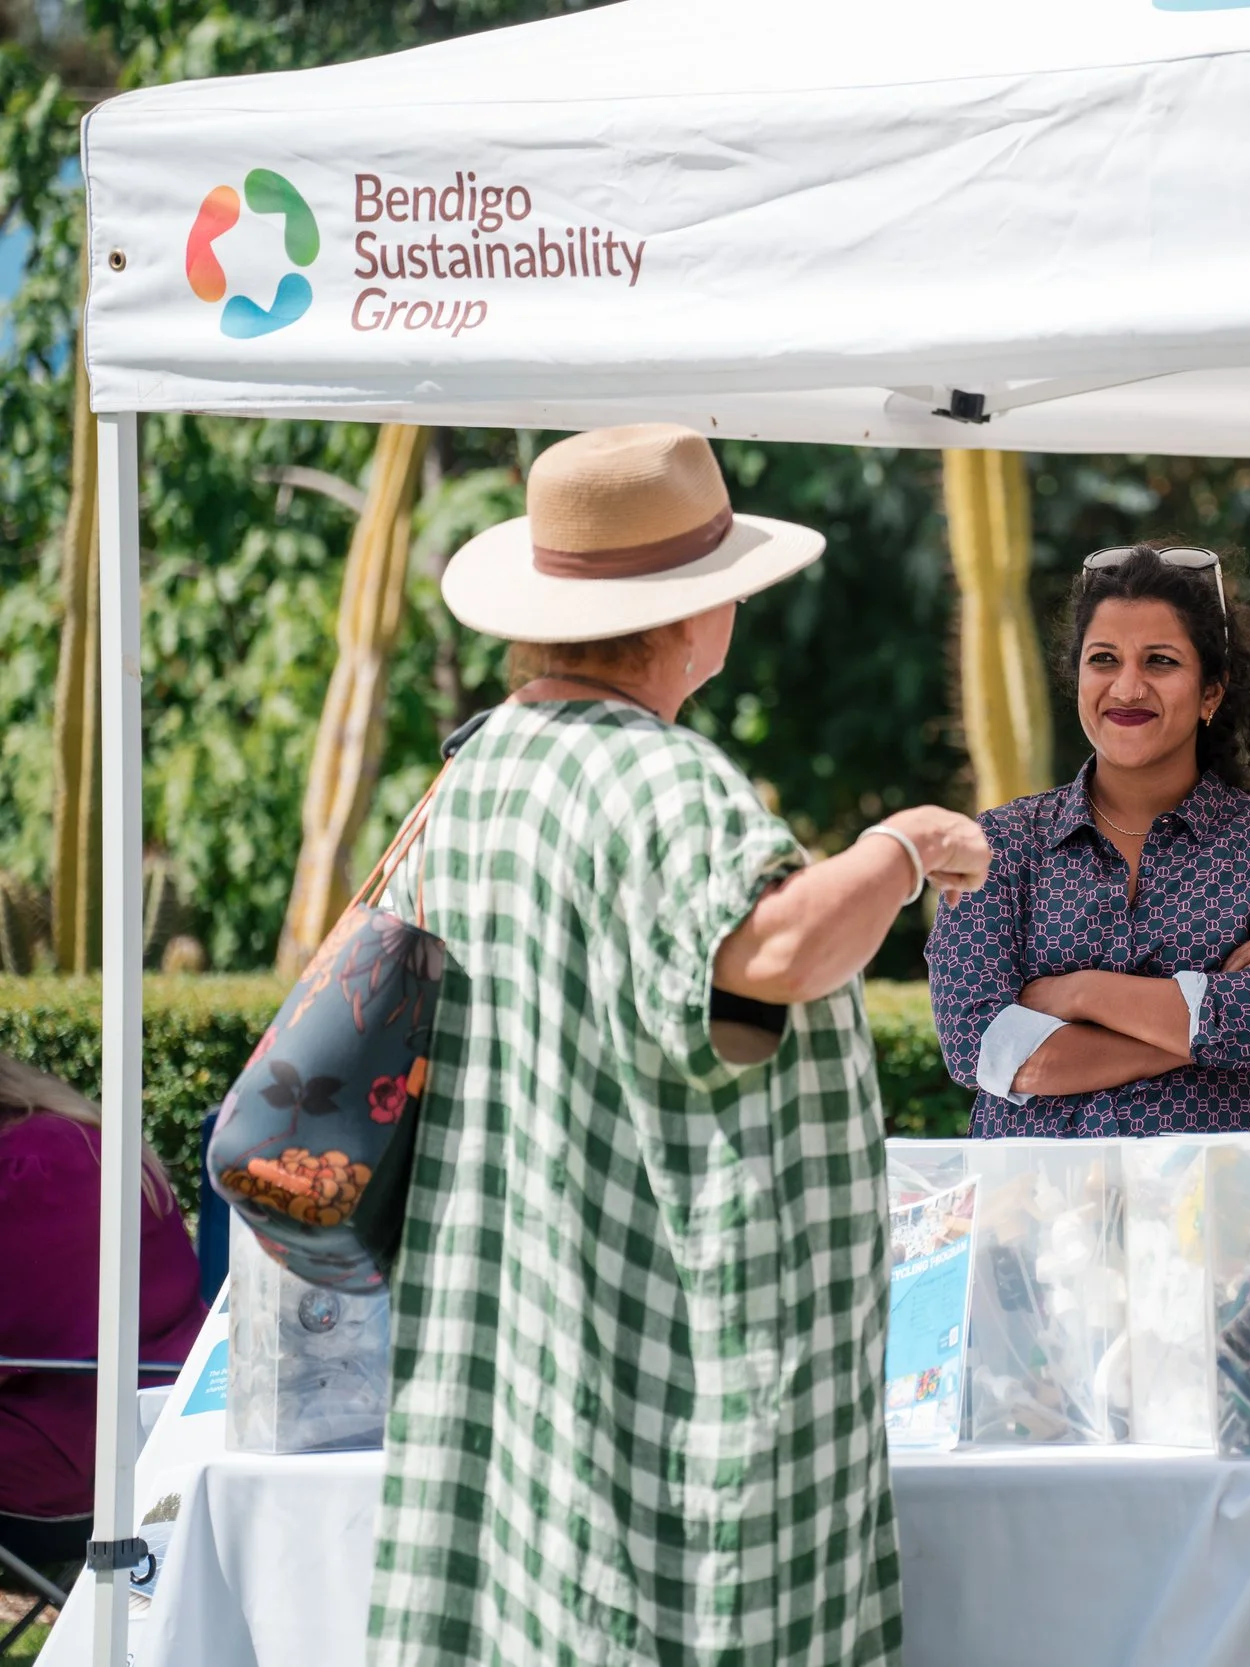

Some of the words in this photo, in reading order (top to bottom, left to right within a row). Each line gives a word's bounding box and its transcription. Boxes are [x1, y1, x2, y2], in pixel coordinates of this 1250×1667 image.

[353, 171, 532, 233] Bendigo
[353, 227, 647, 288] Sustainability
[351, 286, 488, 338] Group
